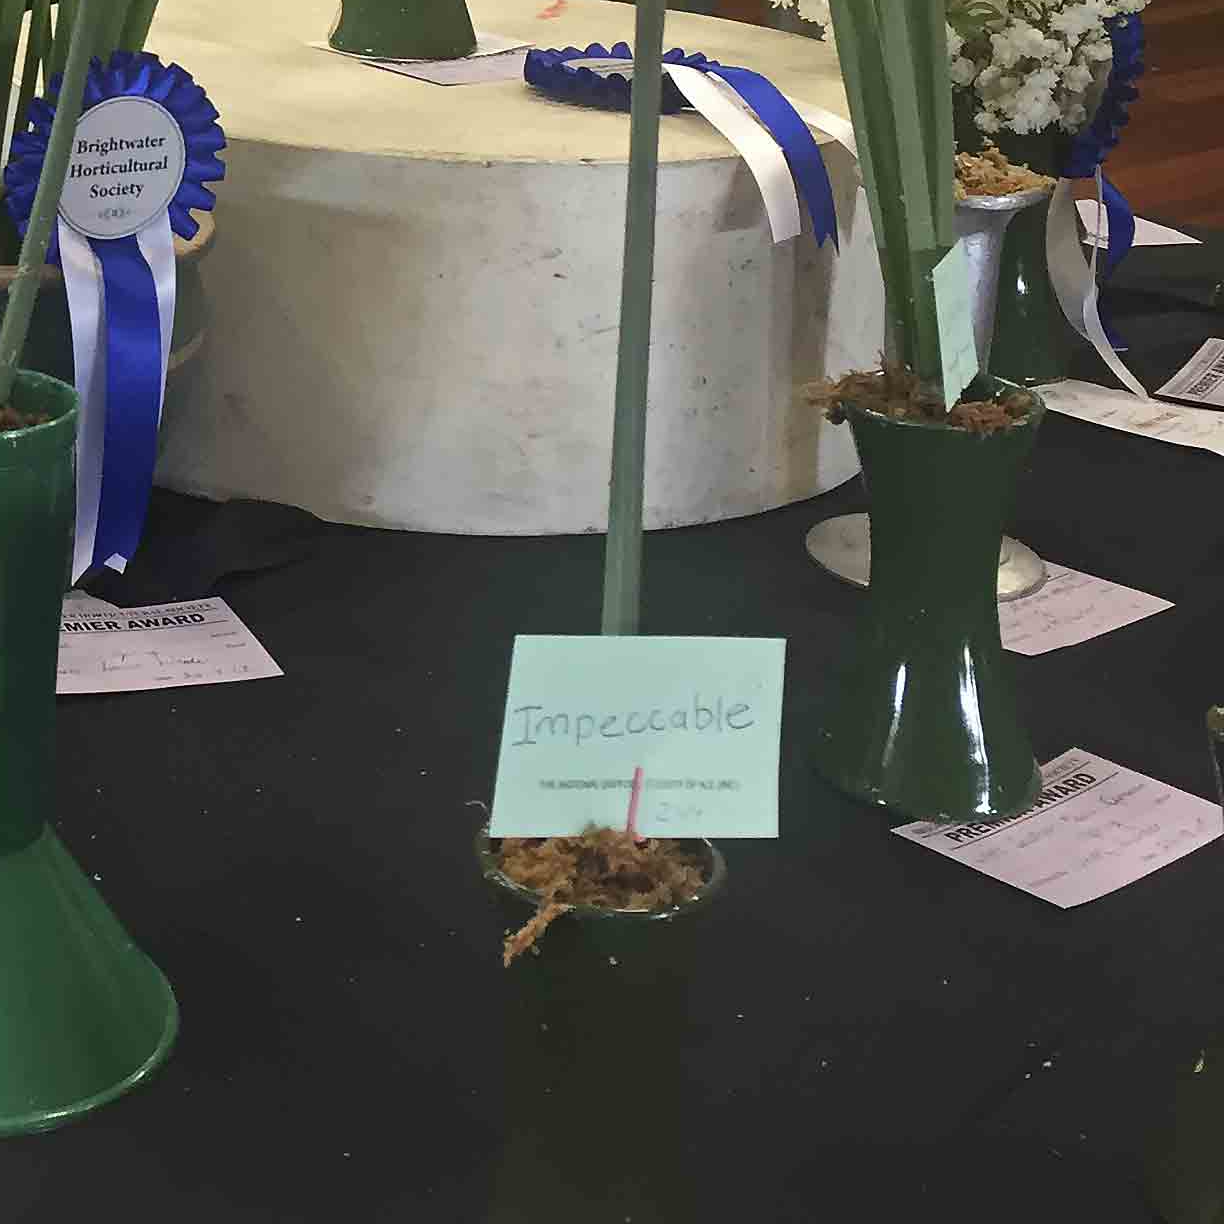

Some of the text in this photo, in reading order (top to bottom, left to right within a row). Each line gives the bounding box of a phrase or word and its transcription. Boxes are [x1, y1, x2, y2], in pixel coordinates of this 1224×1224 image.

[77, 136, 166, 156] Brightwater
[70, 156, 168, 178] Horticultural
[89, 182, 144, 199] Society
[128, 613, 205, 629] AWARD
[512, 692, 755, 746] Impeccable
